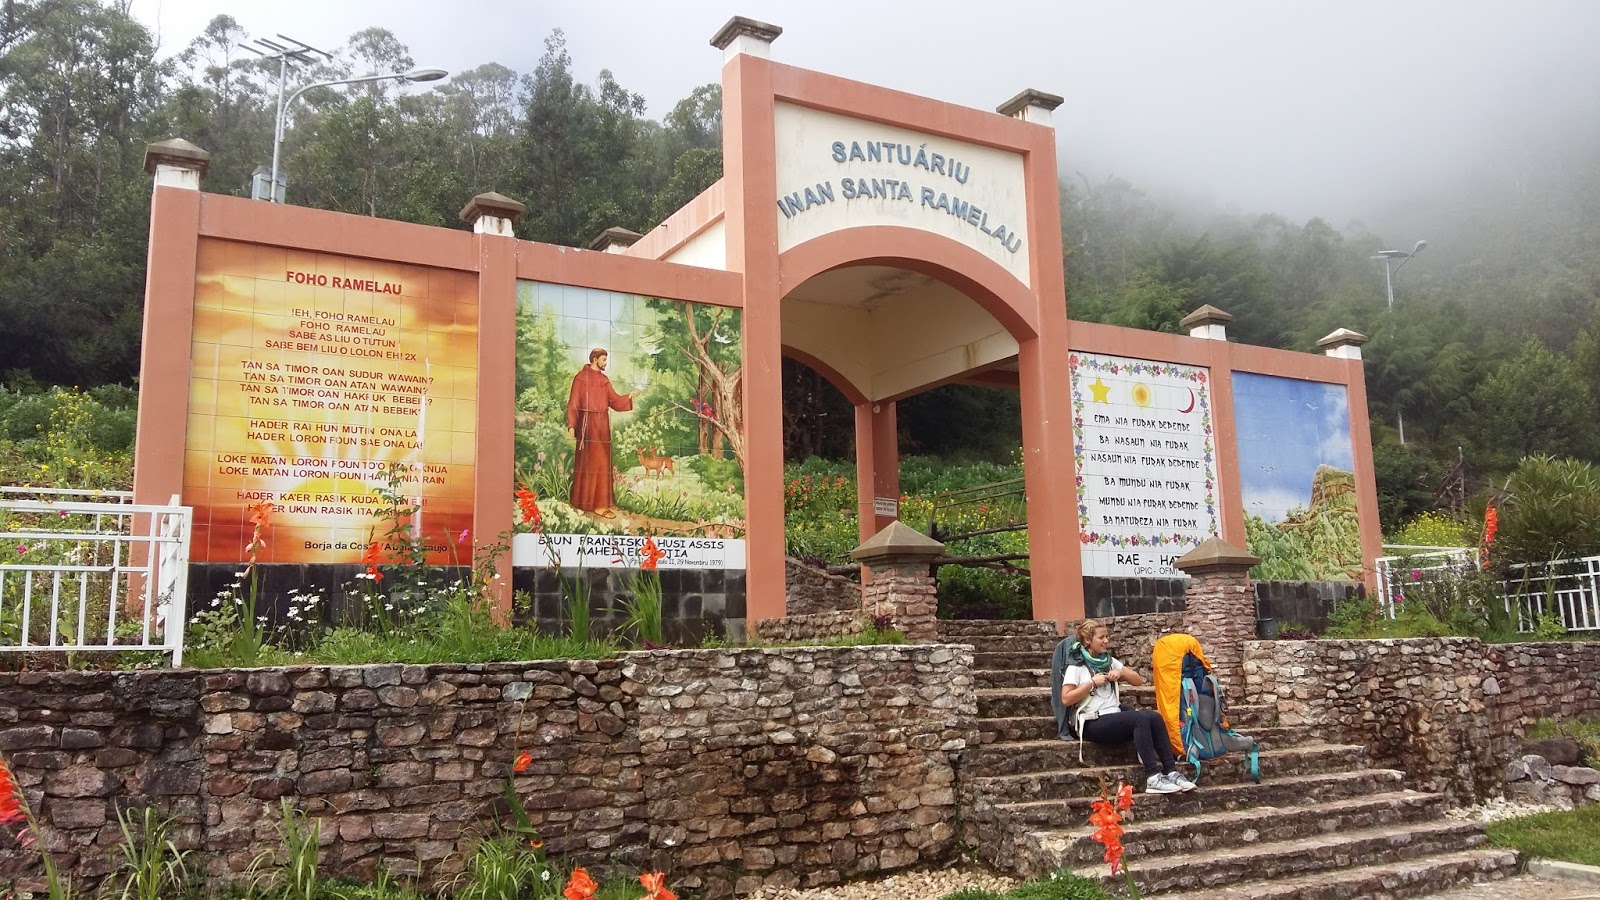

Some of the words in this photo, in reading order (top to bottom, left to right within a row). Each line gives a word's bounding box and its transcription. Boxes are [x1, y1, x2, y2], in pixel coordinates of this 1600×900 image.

[831, 141, 970, 184] SANTUÁRIU
[777, 181, 835, 219] INAN
[841, 177, 913, 203] SANTA
[920, 186, 1022, 254] RAMELAU
[286, 271, 327, 286] FOHO
[332, 276, 402, 295] RAMELAU
[315, 310, 344, 320] FOHO
[347, 314, 395, 326] RAMELAU
[300, 321, 330, 330] FOHO
[336, 324, 385, 336] RAMELAU
[289, 331, 316, 340] SABE
[334, 335, 350, 343] LIU
[362, 338, 396, 348] TUTUN
[266, 340, 293, 350] SABE
[296, 343, 318, 352] BEM
[321, 345, 337, 354] LIU
[350, 348, 382, 358] LOLON
[386, 351, 402, 360] EH!
[405, 352, 416, 361] 2X
[241, 360, 262, 369] TAN
[266, 363, 280, 371] SA
[285, 364, 318, 374] TIMOR
[322, 368, 344, 376] OAN
[349, 370, 383, 379] SUDUR
[388, 373, 434, 384] WAWAIN?
[243, 372, 265, 381] TAN
[288, 376, 321, 385] TIMOR
[324, 379, 347, 387] OAN
[350, 381, 376, 390] ATAN
[381, 384, 428, 394] WAWAIN?
[240, 384, 260, 392] TAN
[264, 386, 278, 394] SA
[282, 387, 314, 396] TIMOR
[318, 390, 339, 398] OAN
[392, 396, 432, 406] BEBEI?
[250, 396, 269, 405] TAN
[273, 398, 287, 406] SA
[292, 399, 324, 408] TIMOR
[328, 402, 349, 411] OAN
[250, 420, 288, 429] HADER
[316, 424, 338, 432] HUN
[342, 426, 374, 434] MUTIN
[1115, 417, 1128, 426] NIA
[247, 432, 285, 441] HADER
[290, 434, 326, 443] LORON
[330, 437, 357, 445] FOUN
[384, 440, 405, 448] ONA
[1099, 435, 1109, 444] BA
[1115, 436, 1145, 448] NASAUN
[1150, 439, 1161, 449] NIA
[218, 454, 246, 464] LOKE
[251, 456, 286, 465] MATAN
[292, 458, 327, 467] LORON
[332, 460, 360, 469] FOUN
[362, 462, 385, 470] TO'O
[1091, 453, 1122, 463] NASAUN
[1124, 453, 1136, 464] NIA
[220, 466, 248, 475] LOKE
[253, 468, 288, 476] MATAN
[294, 470, 329, 478] LORON
[334, 472, 361, 480] FOUN
[423, 476, 444, 484] RAIN
[1104, 477, 1115, 486] BA
[1119, 477, 1146, 488] MUNDU
[1150, 480, 1162, 489] NIA
[237, 492, 273, 500] HADER
[280, 493, 310, 502] KA'ER
[315, 494, 346, 502] RASIK
[352, 496, 378, 504] KUDA
[1099, 497, 1126, 506] MUNDU
[1128, 498, 1141, 507] NIA
[248, 504, 285, 512] HER
[289, 505, 317, 514] UKUN
[358, 507, 372, 516] ITA
[1103, 515, 1113, 525] BA
[1156, 518, 1169, 527] NIA
[304, 541, 332, 551] Borja
[350, 542, 375, 550] Cos
[658, 539, 685, 548] HUSI
[689, 541, 724, 549] ASSIS
[1117, 554, 1139, 565] RAE
